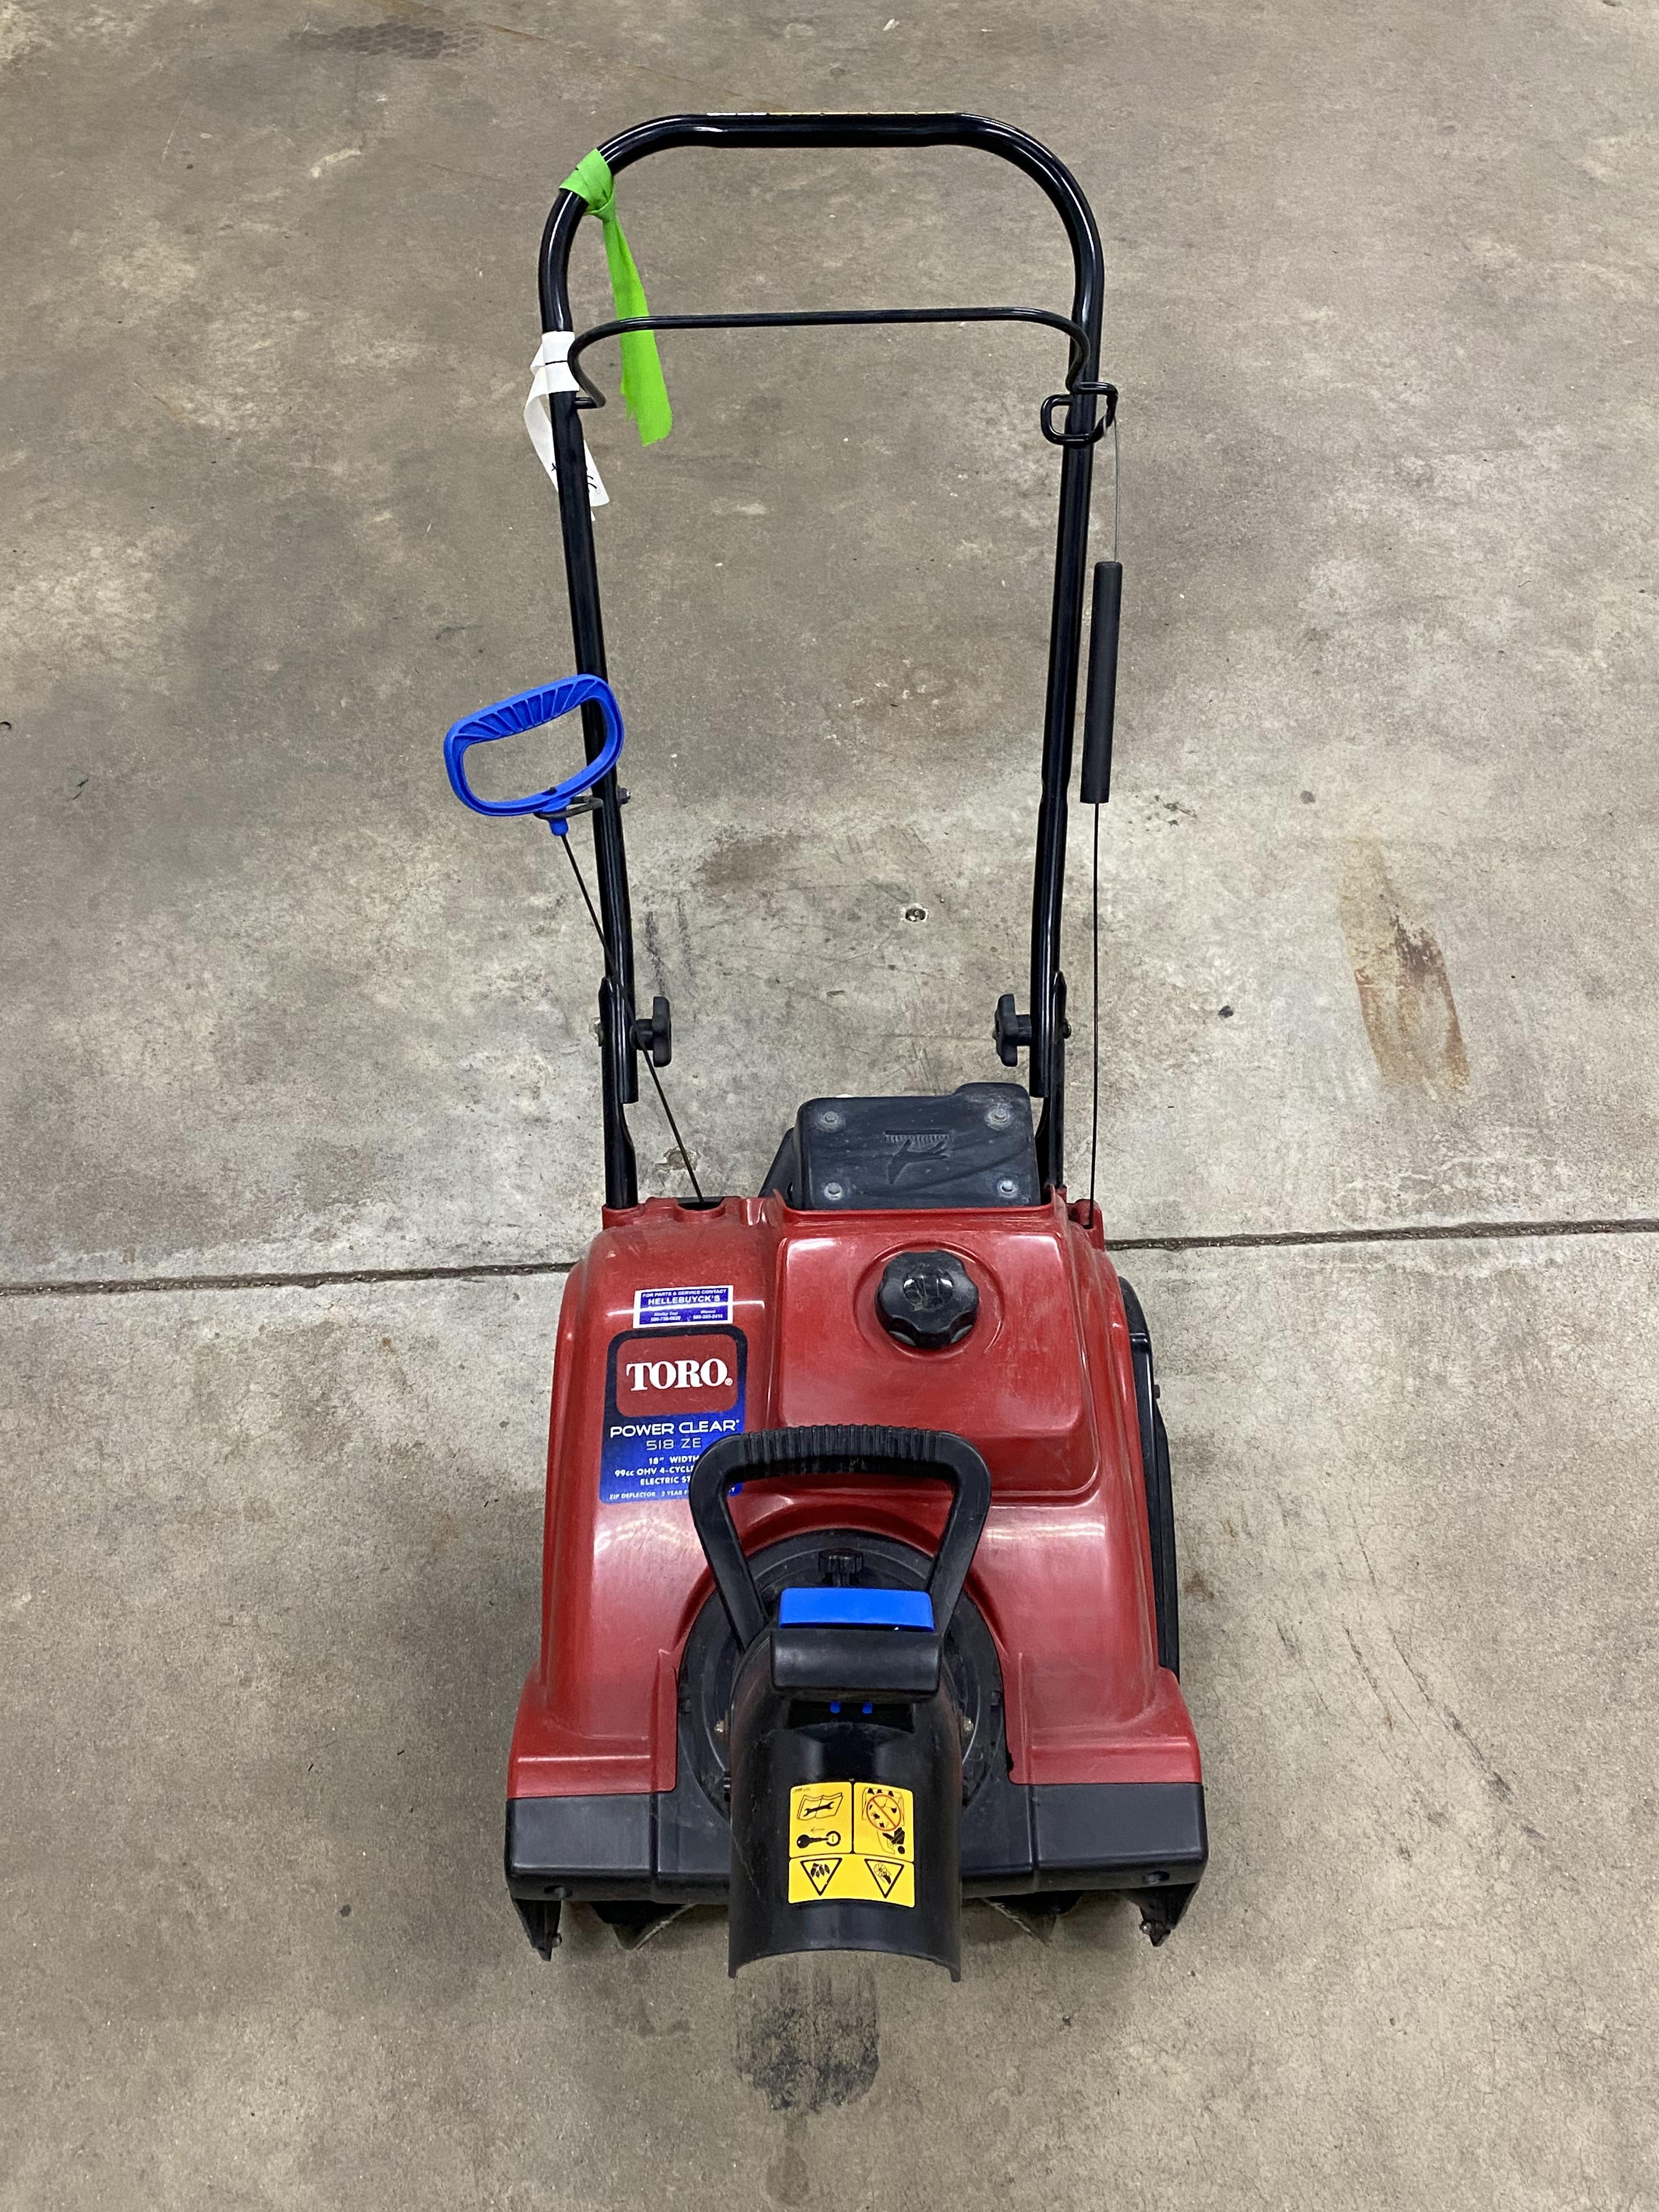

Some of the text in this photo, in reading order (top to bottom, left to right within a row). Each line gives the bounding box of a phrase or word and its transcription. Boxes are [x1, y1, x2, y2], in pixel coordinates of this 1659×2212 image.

[647, 1295, 720, 1305] HELLEBUYCK'S
[610, 1423, 675, 1438] POWER
[646, 1437, 702, 1451] 518 ZE
[669, 1455, 700, 1464] WIDTH
[636, 1467, 657, 1476] OHV
[640, 1476, 680, 1486] ELECTRIC
[621, 1491, 656, 1499] DEFLECTOR
